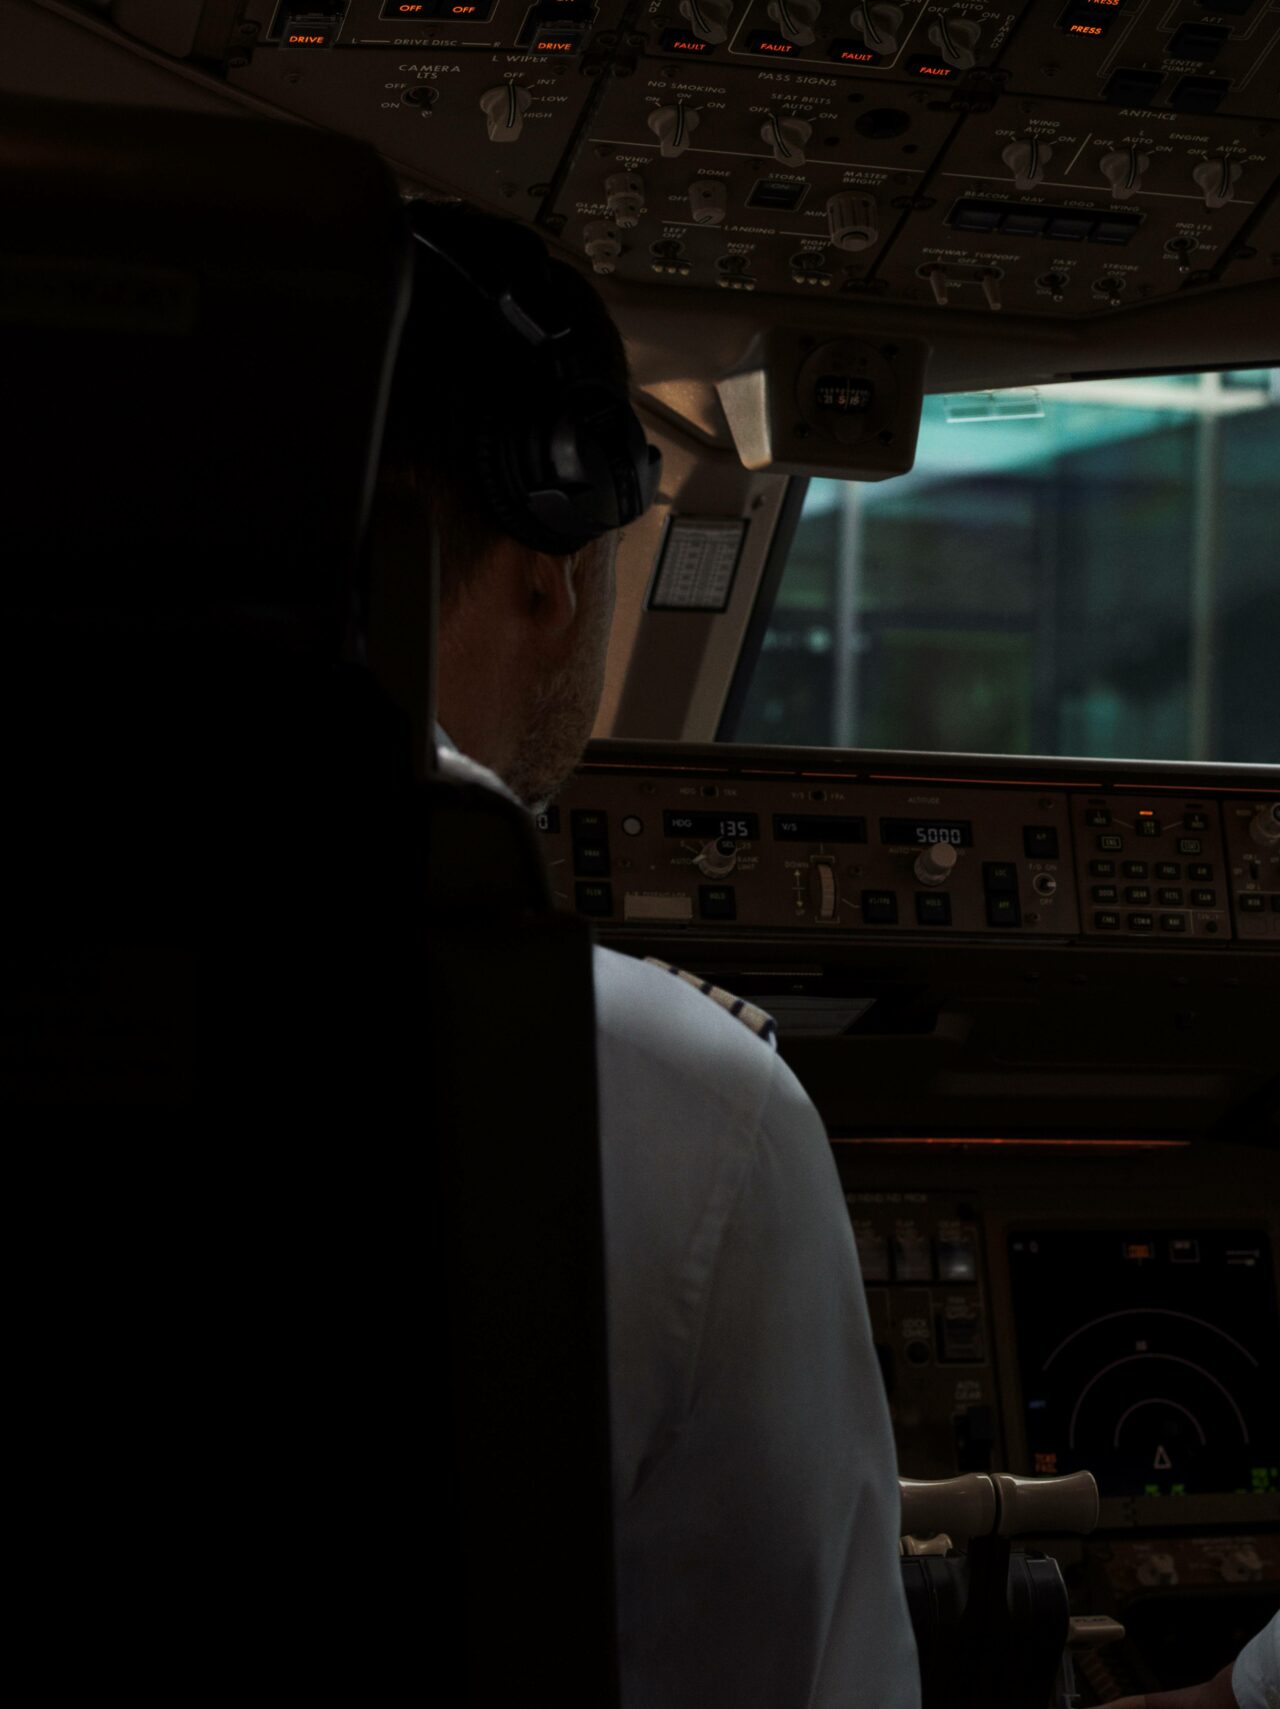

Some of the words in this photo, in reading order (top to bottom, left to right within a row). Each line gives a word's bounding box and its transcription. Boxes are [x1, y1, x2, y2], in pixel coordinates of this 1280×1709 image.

[399, 4, 423, 13] OFF
[453, 5, 476, 14] OFF
[928, 6, 949, 14] OFF
[952, 3, 983, 12] AUTO
[982, 12, 1000, 20] ON
[1070, 24, 1103, 35] PRESS
[290, 36, 325, 45] DRIVE
[394, 38, 429, 47] DRIVE
[432, 39, 458, 48] DISC
[537, 42, 572, 52] DRIVE
[674, 41, 706, 52] FAULT
[760, 43, 792, 53] FAULT
[507, 55, 548, 65] WIPER
[841, 52, 873, 62] FAULT
[399, 63, 461, 74] CAMERA
[920, 66, 952, 77] FAULT
[417, 72, 438, 80] LTS
[504, 71, 526, 79] OFF
[758, 71, 791, 83] PASS
[796, 75, 838, 88] SIGNS
[385, 82, 408, 91] OFF
[536, 78, 557, 86] INT
[648, 80, 666, 89] NO
[671, 82, 727, 95] SMOKING
[541, 94, 568, 103] LOW
[381, 102, 400, 110] ON
[707, 102, 726, 110] ON
[750, 105, 770, 113] OFF
[782, 102, 813, 112] AUTO
[819, 112, 838, 121] ON
[1119, 108, 1178, 122] ANTI-ICE
[1029, 119, 1061, 129] WING
[995, 129, 1016, 138] OFF
[1024, 127, 1057, 136] AUTO
[1058, 136, 1078, 144] ON
[1093, 138, 1114, 147] OFF
[1123, 136, 1154, 146] AUTO
[1169, 133, 1210, 144] ENGINE
[1155, 145, 1174, 153] ON
[1216, 145, 1247, 155] AUTO
[1248, 153, 1267, 162] ON
[697, 168, 731, 178] DOME
[769, 172, 806, 182] STORM
[844, 170, 888, 181] MASTER
[844, 178, 884, 187] BRIGHT
[964, 190, 1009, 201] BEACON
[1020, 195, 1045, 205] NAV
[1064, 200, 1096, 210] LOGO
[1110, 204, 1141, 214] WING
[804, 210, 827, 219] MIN
[725, 225, 776, 236] LANDING
[923, 247, 968, 258] RUNWAY
[671, 818, 693, 828] HDG
[782, 822, 797, 832] V/S
[720, 820, 749, 837] 135
[916, 828, 961, 845] 5000
